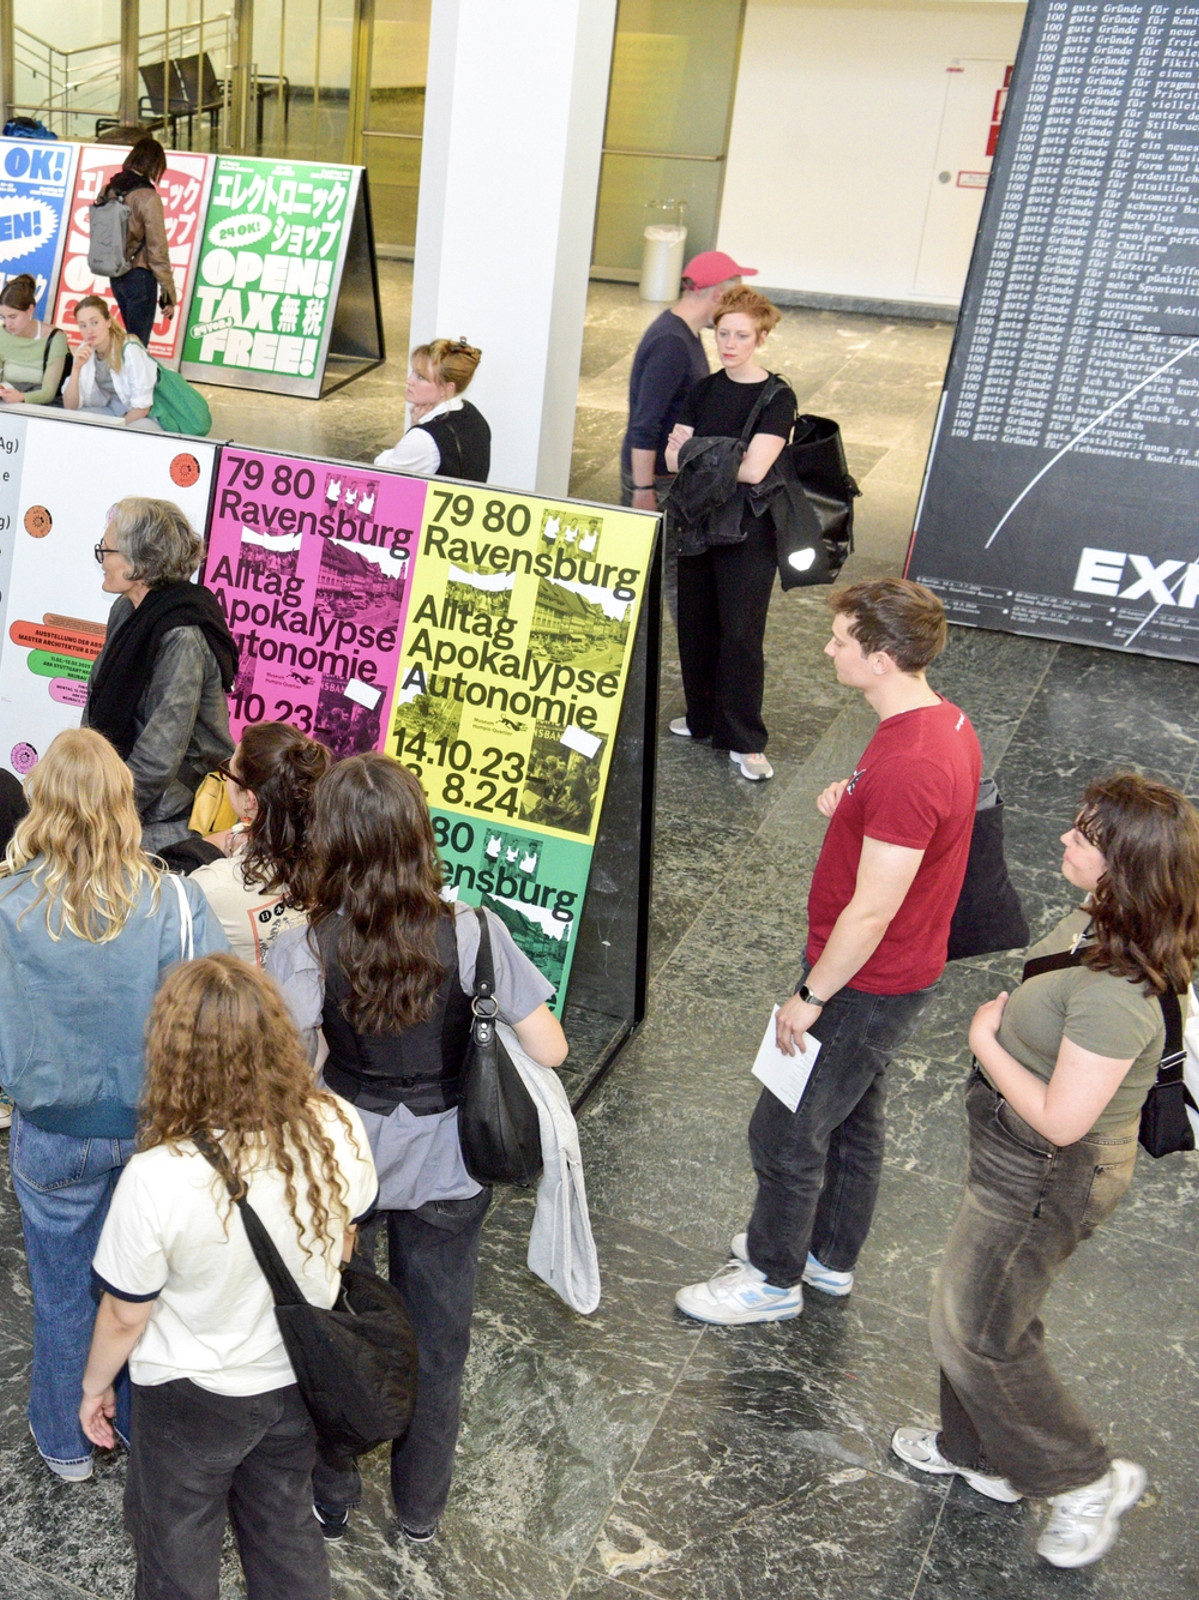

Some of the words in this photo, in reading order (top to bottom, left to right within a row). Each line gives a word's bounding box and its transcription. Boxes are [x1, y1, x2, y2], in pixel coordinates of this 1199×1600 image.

[1043, 23, 1063, 32] 100
[1067, 24, 1094, 35] gute
[1099, 25, 1138, 35] Gründe
[1143, 27, 1164, 36] für
[1169, 29, 1196, 37] neue
[1020, 123, 1039, 132] 100
[1043, 125, 1070, 136] gute
[1074, 127, 1113, 137] Gründe
[1118, 129, 1139, 138] für
[1143, 131, 1164, 140] Mut
[5, 147, 65, 181] OK!
[1008, 173, 1028, 182] 100
[1032, 174, 1058, 186] gute
[1063, 177, 1101, 187] Gründe
[1106, 180, 1126, 189] für
[1131, 181, 1190, 193] Intuition
[213, 174, 347, 221] エレクトロニック
[1002, 202, 1021, 211] 100
[1025, 204, 1051, 215] gute
[1056, 206, 1094, 217] Gründe
[1099, 209, 1119, 219] für
[1123, 211, 1176, 223] Herzblut
[219, 227, 235, 240] 24
[237, 221, 261, 236] OK!
[271, 216, 341, 258] ショップ
[993, 241, 1012, 250] 100
[1016, 243, 1042, 254] gute
[1046, 245, 1085, 256] Gründe
[1089, 249, 1109, 258] für
[1114, 251, 1159, 263] Zufälle
[995, 231, 1014, 240] 100
[1018, 233, 1044, 245] gute
[1049, 235, 1087, 246] Gründe
[1091, 239, 1112, 248] für
[1116, 241, 1168, 253] Charisma
[201, 248, 333, 299] OPEN!
[984, 279, 1003, 288] 100
[1007, 281, 1033, 293] gute
[1037, 284, 1075, 295] Gründe
[1080, 288, 1100, 297] für
[1104, 290, 1156, 303] Kontrast
[197, 286, 279, 331] TAX
[978, 307, 997, 317] 100
[1001, 310, 1026, 322] gute
[1031, 313, 1068, 324] Gründe
[1073, 317, 1092, 326] für
[1097, 319, 1123, 330] mehr
[1128, 322, 1161, 333] lesen
[980, 298, 999, 307] 100
[1003, 300, 1028, 312] gute
[1033, 303, 1070, 314] Gründe
[1075, 307, 1095, 317] für
[1099, 310, 1144, 322] Offline
[199, 328, 318, 376] FREE!
[971, 335, 990, 345] 100
[994, 338, 1019, 350] gute
[1024, 341, 1061, 353] Gründe
[1066, 346, 1085, 355] für
[1090, 348, 1166, 364] Sichtbarkeit
[227, 456, 266, 490] 79
[272, 464, 315, 500] 80
[219, 493, 413, 560] Ravensburg
[432, 491, 474, 527] 79
[486, 501, 532, 537] 80
[210, 556, 305, 608] Alltag
[424, 526, 640, 601] Ravensburg
[35, 629, 77, 643] AUSSTELLUNG
[78, 638, 89, 646] DER
[90, 640, 104, 648] ABS
[213, 587, 397, 652] Apokalypse
[413, 595, 516, 650] Alltag
[19, 634, 42, 644] MASTER
[43, 638, 84, 652] ARCHITEKTUR
[235, 633, 378, 682] utonomie
[407, 629, 619, 699] Apokalypse
[402, 662, 599, 730] Autonomie
[442, 772, 519, 818] 8.24
[433, 816, 475, 853] 80
[441, 861, 578, 922] ensburg
